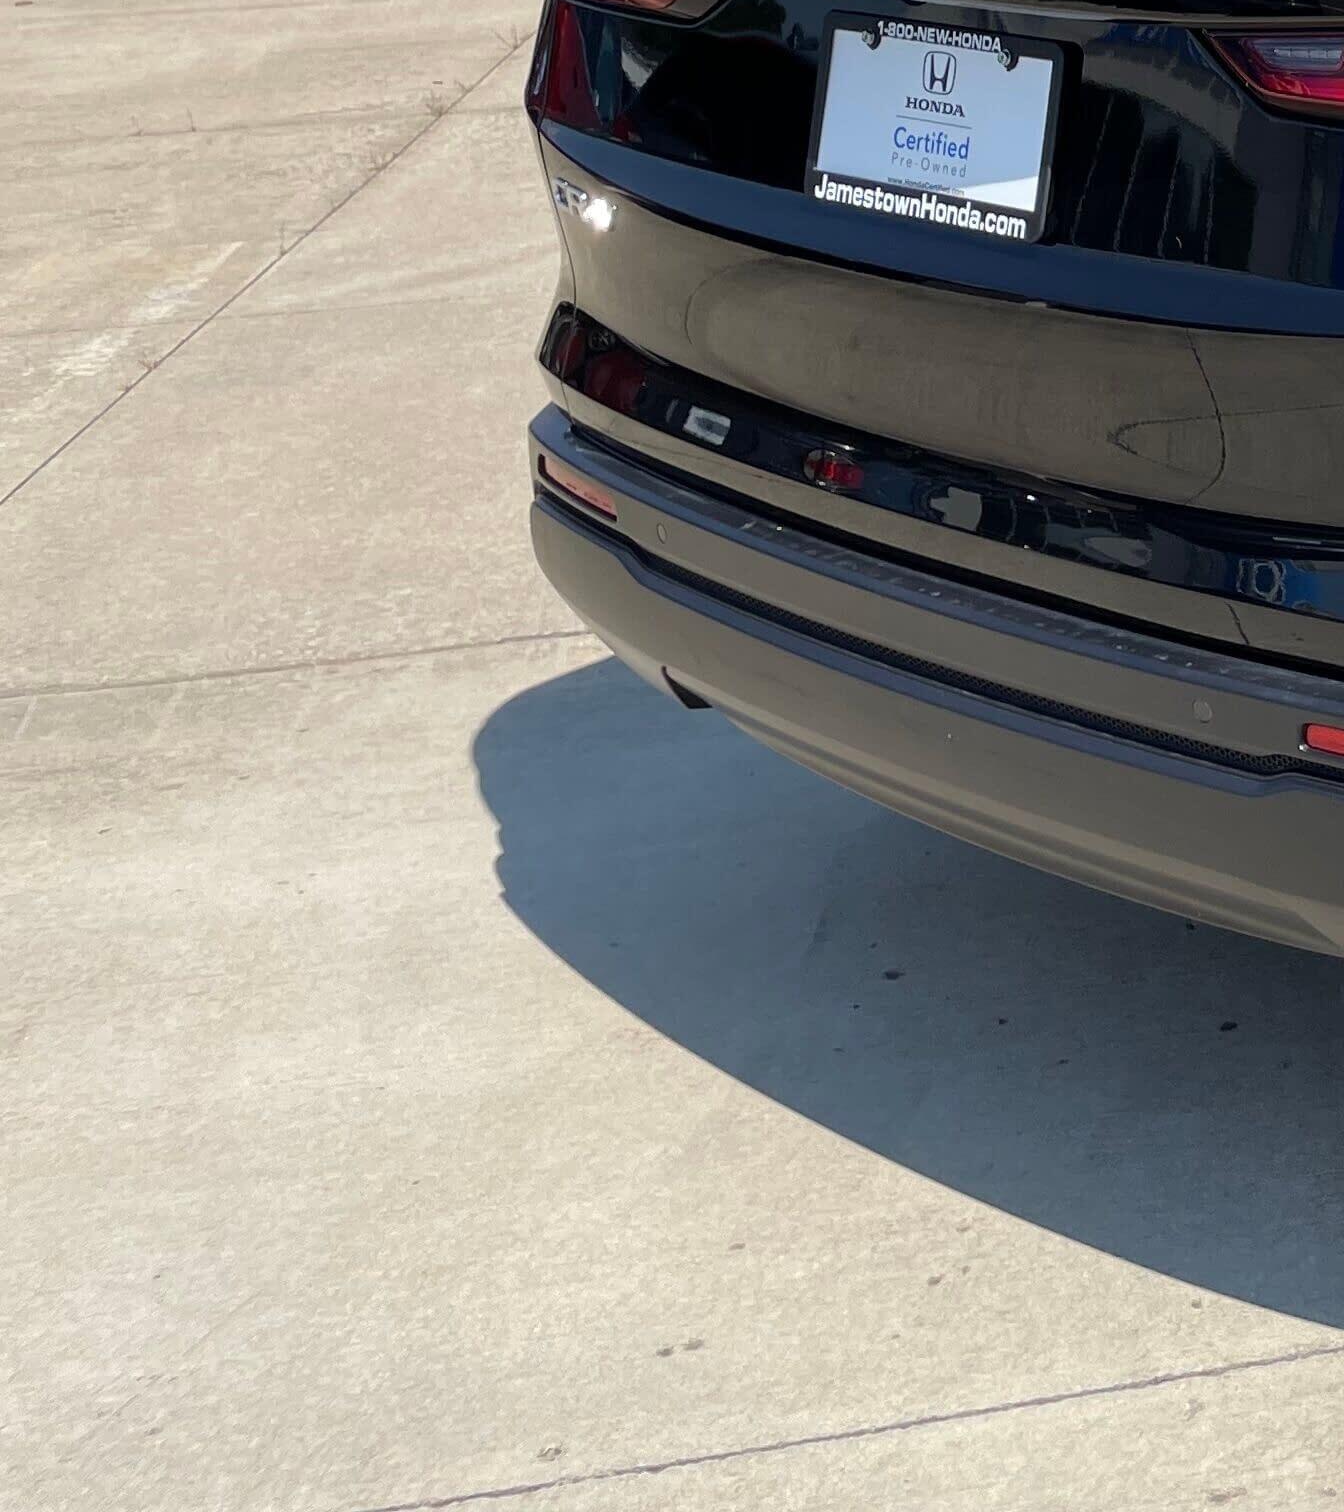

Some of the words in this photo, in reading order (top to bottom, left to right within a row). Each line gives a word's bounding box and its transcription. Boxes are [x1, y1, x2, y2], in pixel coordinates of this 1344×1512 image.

[877, 21, 1002, 53] 1-800-NEW-HONDA
[904, 96, 966, 118] HONDA
[893, 126, 970, 161] Certified
[891, 152, 967, 178] Pre-Owned
[814, 173, 1027, 239] JamestownHonda.com
